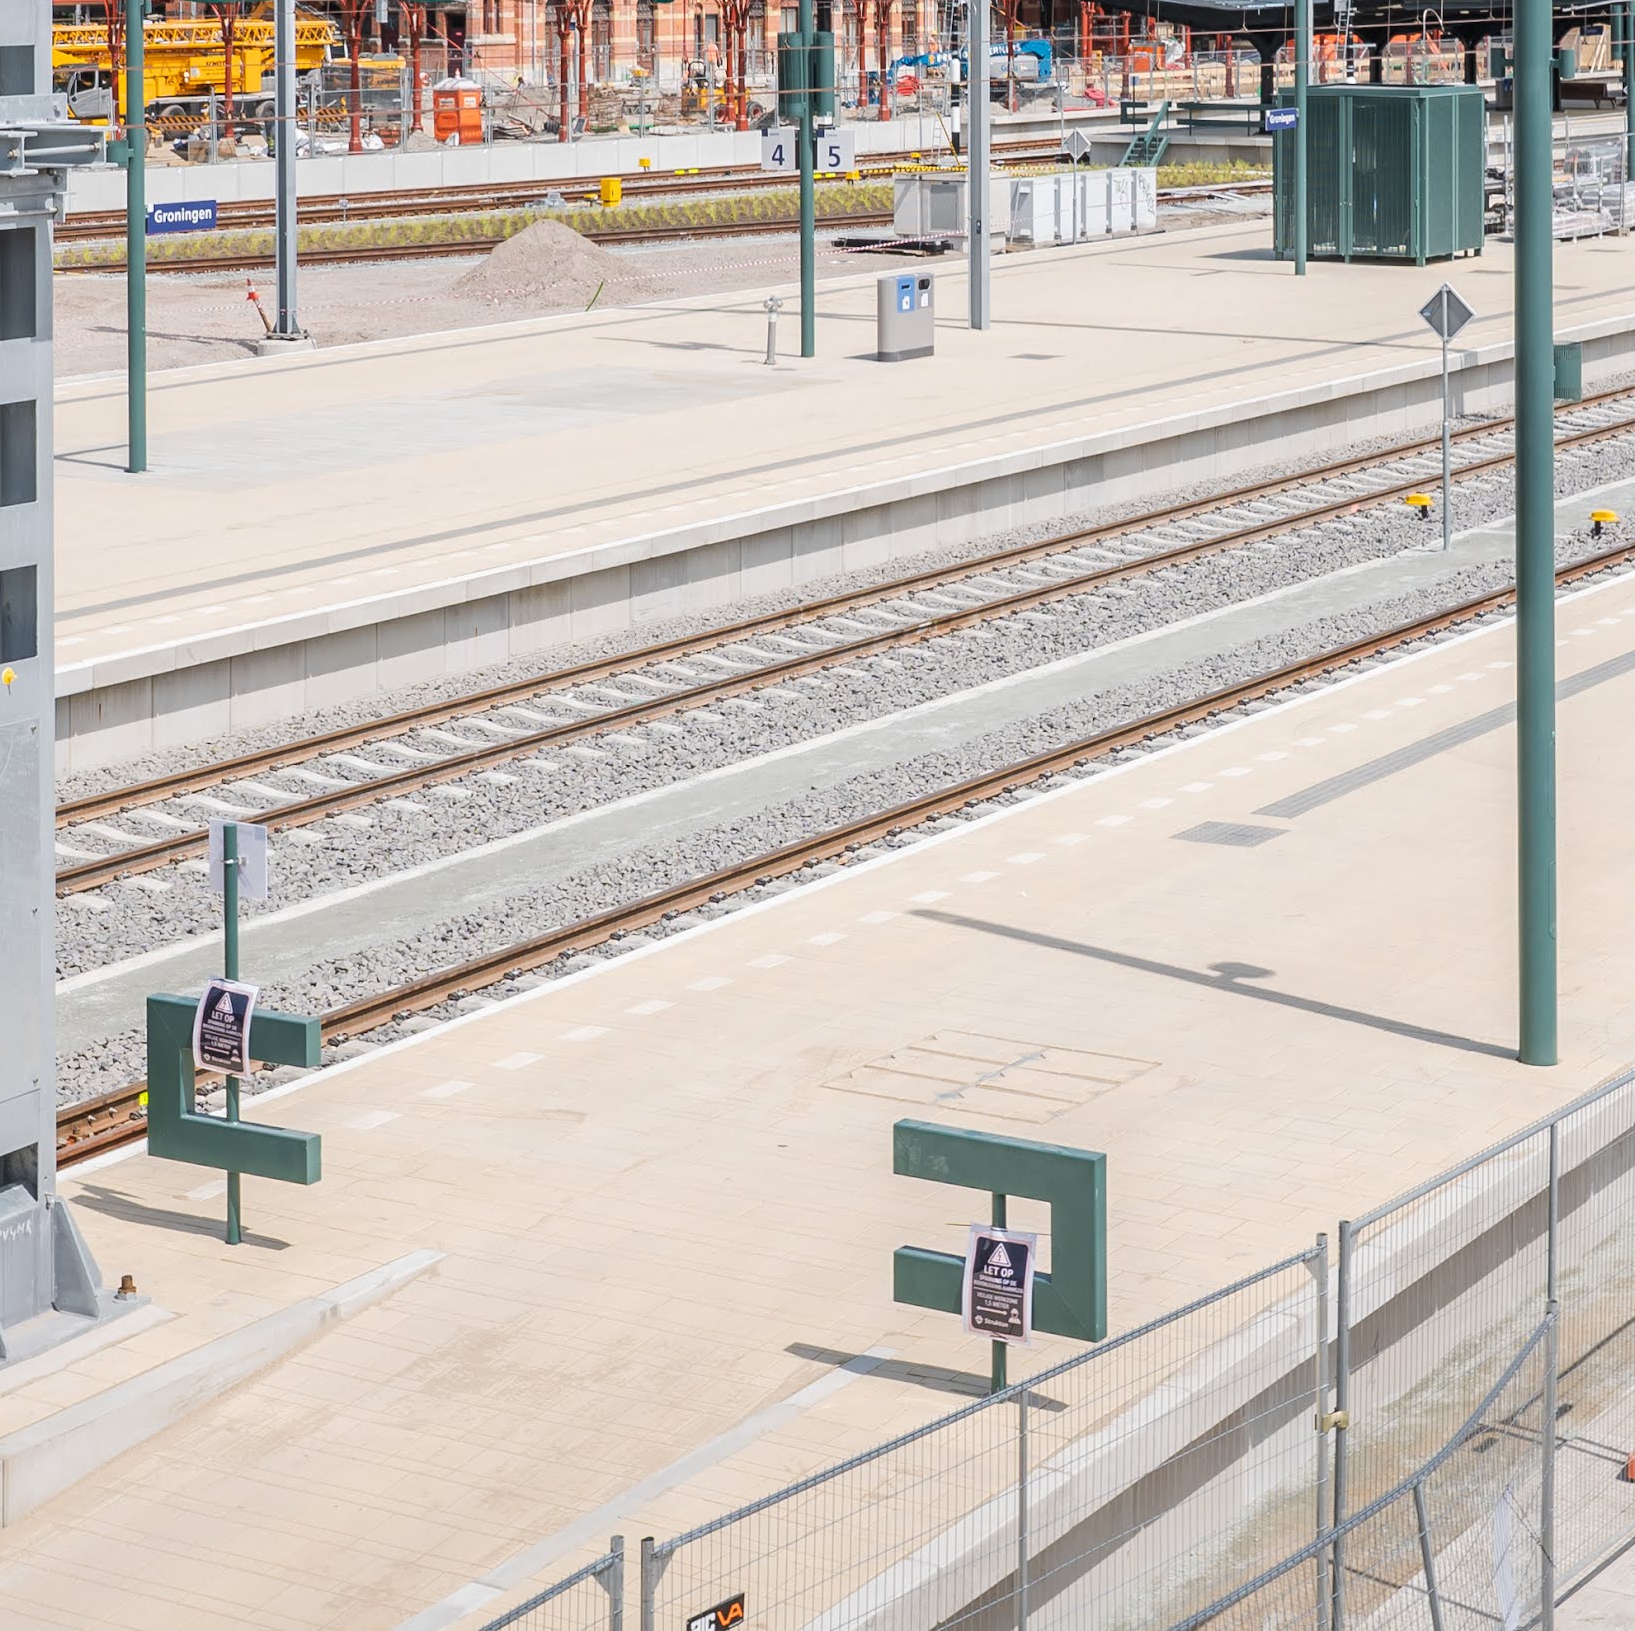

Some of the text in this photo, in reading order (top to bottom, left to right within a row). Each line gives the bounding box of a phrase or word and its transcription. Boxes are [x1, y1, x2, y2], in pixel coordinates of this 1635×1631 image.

[771, 144, 785, 166] 4
[828, 145, 841, 168] 5
[153, 207, 213, 225] Groningen
[211, 1010, 235, 1023] LET OP
[983, 1264, 1014, 1278] LET OP
[984, 1317, 1009, 1328] Strukton
